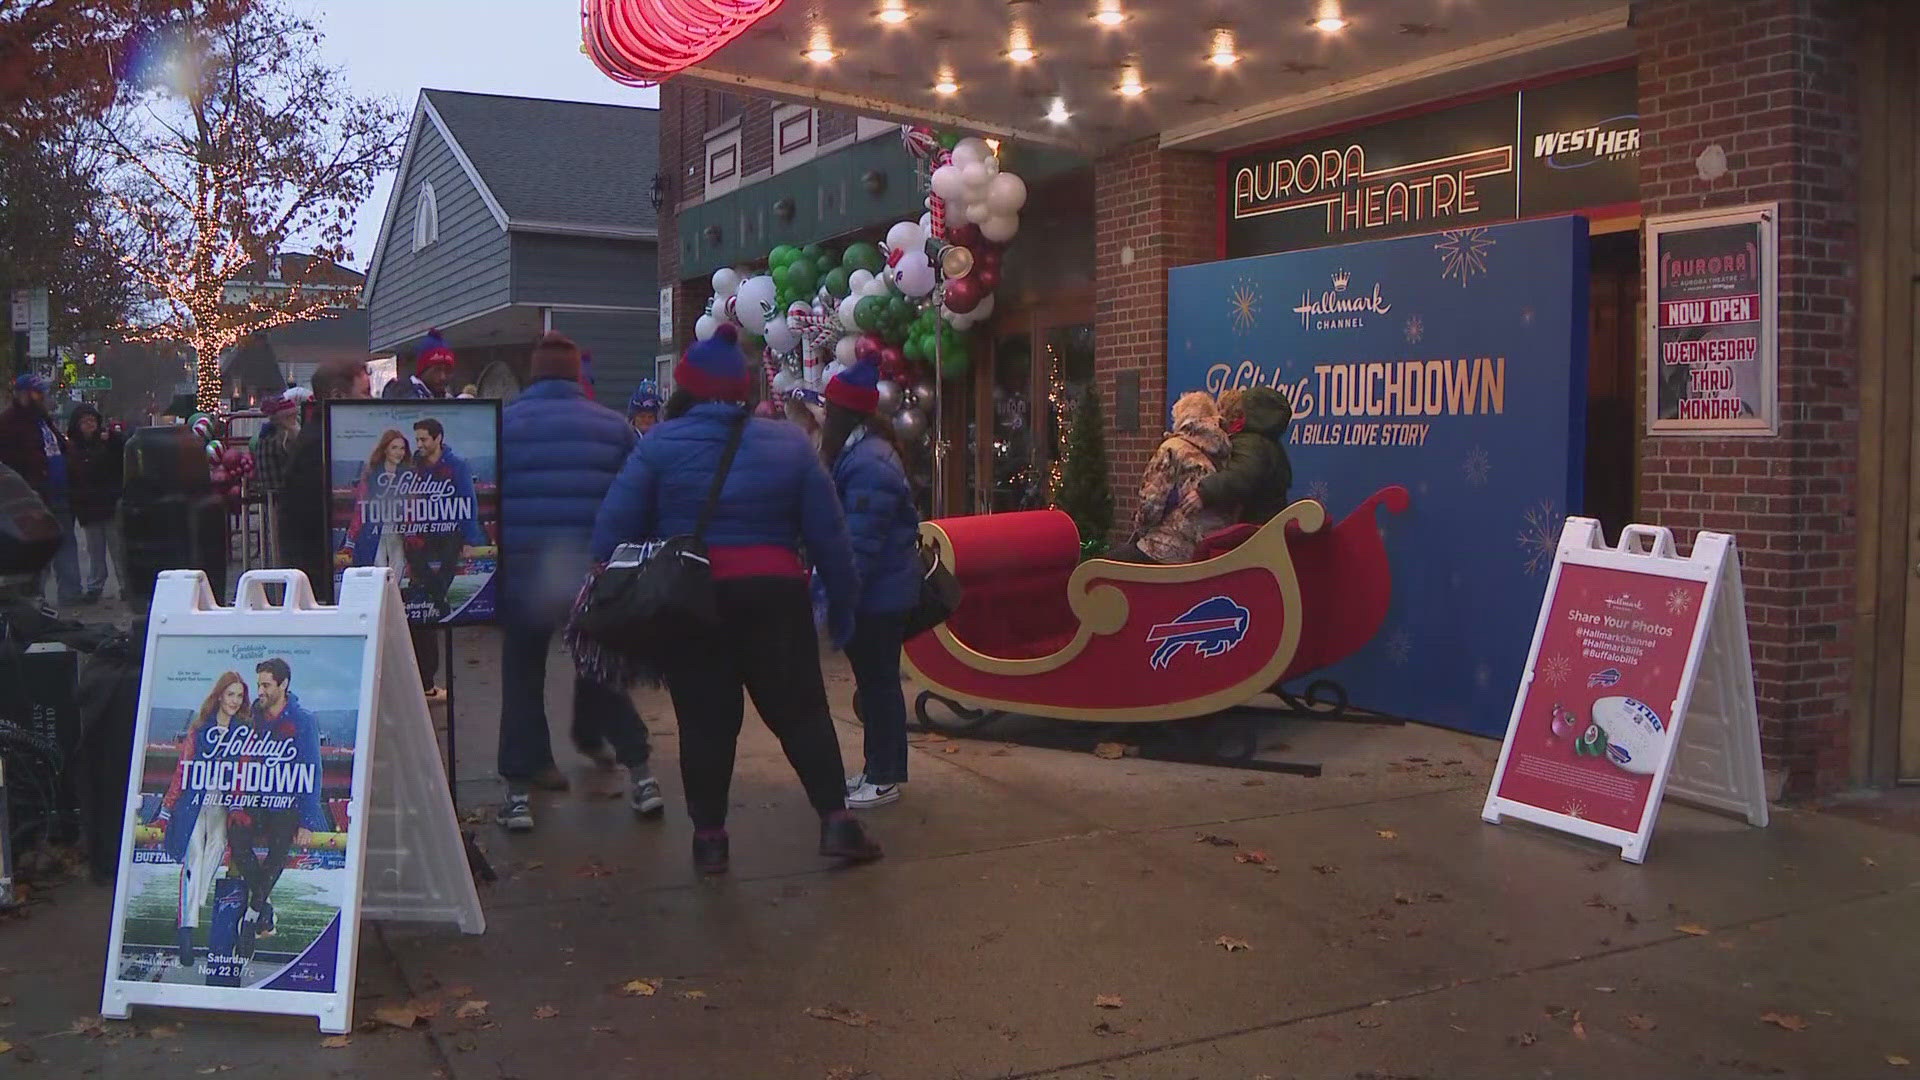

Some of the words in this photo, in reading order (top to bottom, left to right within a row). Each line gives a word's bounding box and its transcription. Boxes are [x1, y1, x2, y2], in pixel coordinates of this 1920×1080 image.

[1534, 127, 1640, 158] WESTHER
[1608, 152, 1627, 161] NEW
[1235, 144, 1366, 208] AURORA
[1323, 170, 1479, 233] THEATRE
[1671, 253, 1747, 278] AURORA
[1292, 282, 1392, 331] Hallmark
[1668, 302, 1705, 326] NOW
[1710, 298, 1751, 322] OPEN
[1316, 318, 1364, 331] CHANNEL
[1664, 338, 1756, 364] WEDNESDAY
[1314, 357, 1505, 417] TOUCHDOWN
[1690, 368, 1730, 392] THRU
[1680, 397, 1741, 420] MONDAY
[1289, 425, 1301, 445] A
[1302, 424, 1342, 446] BILLS
[1343, 424, 1379, 445] LOVE
[1380, 424, 1430, 446] STORY
[377, 470, 455, 502] Holiday
[358, 497, 472, 524] TOUCHDOWN
[371, 525, 379, 535] A
[381, 524, 406, 534] BILLS
[406, 523, 430, 533] LOVE
[430, 522, 458, 533] STORY
[405, 601, 434, 611] aturday
[1604, 594, 1644, 610] Hallmark
[411, 610, 421, 618] 22
[1568, 609, 1601, 625] Share
[1603, 615, 1631, 629] Your
[1631, 621, 1673, 637] Photos
[1576, 627, 1656, 648] @HallmarkChannel
[1582, 638, 1644, 656] #HallmarkBills
[1582, 648, 1638, 665] @Buffalobills
[202, 725, 298, 767] Holiday
[179, 760, 315, 793] TOUCHDOWN
[191, 794, 199, 805] A
[202, 794, 234, 806] BILLS
[234, 795, 260, 808] LOVE
[259, 796, 295, 808] STORY
[134, 852, 177, 863] BUFFAL
[198, 965, 217, 976] Nov
[218, 966, 231, 976] 22
[207, 952, 249, 966] Saturday
